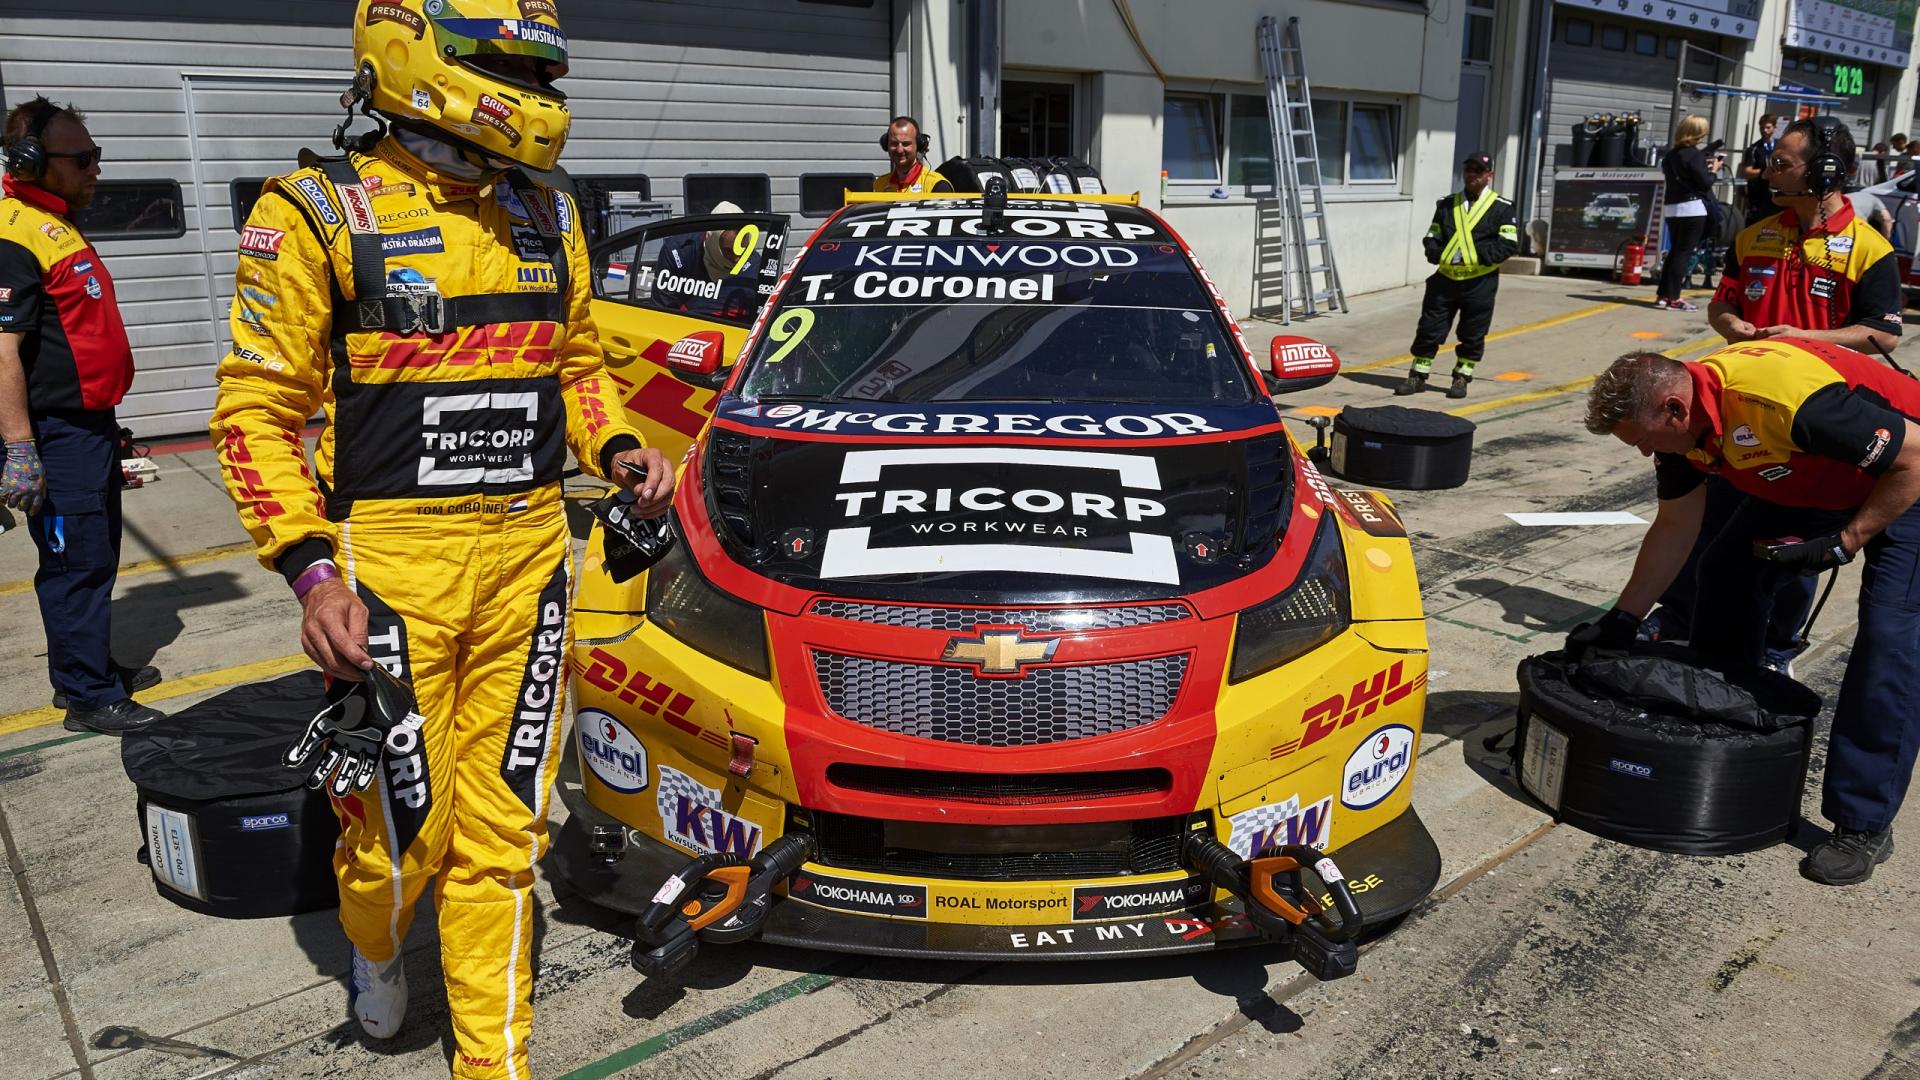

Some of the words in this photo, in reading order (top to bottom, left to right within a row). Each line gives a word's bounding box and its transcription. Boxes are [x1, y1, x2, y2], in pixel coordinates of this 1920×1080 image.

[371, 6, 419, 26] PRESTIGE
[520, 27, 556, 46] DIJKSTRA
[417, 98, 429, 109] 64
[478, 111, 517, 138] PRESTIGE
[297, 177, 339, 224] sparco
[343, 186, 371, 230] SIMPSON
[408, 236, 443, 248] DRAISMA
[847, 218, 1156, 240] TRICORP
[730, 224, 760, 275] 9
[854, 245, 1140, 268] KENWOOD
[639, 265, 652, 287] T.
[656, 268, 723, 300] Coronel
[801, 275, 834, 302] T.
[854, 271, 1054, 301] Coronel
[377, 320, 558, 370] DHL
[765, 308, 816, 363] 9
[775, 407, 1224, 436] McGREGOR
[421, 428, 535, 451] TRICORP
[449, 453, 513, 463] WORKWEAR
[224, 423, 287, 525] DHL
[416, 505, 443, 516] TOM
[447, 501, 506, 515] CORONEL
[835, 486, 1167, 522] TRICORP
[910, 521, 1089, 538] WORKWEAR
[506, 601, 564, 771] TRICORP
[582, 646, 703, 738] DHL
[1297, 659, 1415, 751] DHL
[581, 731, 643, 779] eurol
[1347, 743, 1410, 793] eurol
[1612, 760, 1651, 776] sparco
[1346, 769, 1406, 801] LUBRICANTS
[243, 813, 287, 828] sparco
[676, 795, 761, 861] KW
[1249, 799, 1332, 860] KW
[153, 824, 165, 869] CORONEL
[172, 829, 181, 852] SET3
[813, 882, 895, 906] YOKOHAMA
[935, 895, 981, 909] ROAL
[985, 896, 1068, 911] Motorsport
[1103, 888, 1185, 909] YOKOHAMA
[1010, 928, 1075, 949] EAT
[1095, 922, 1146, 941] MY
